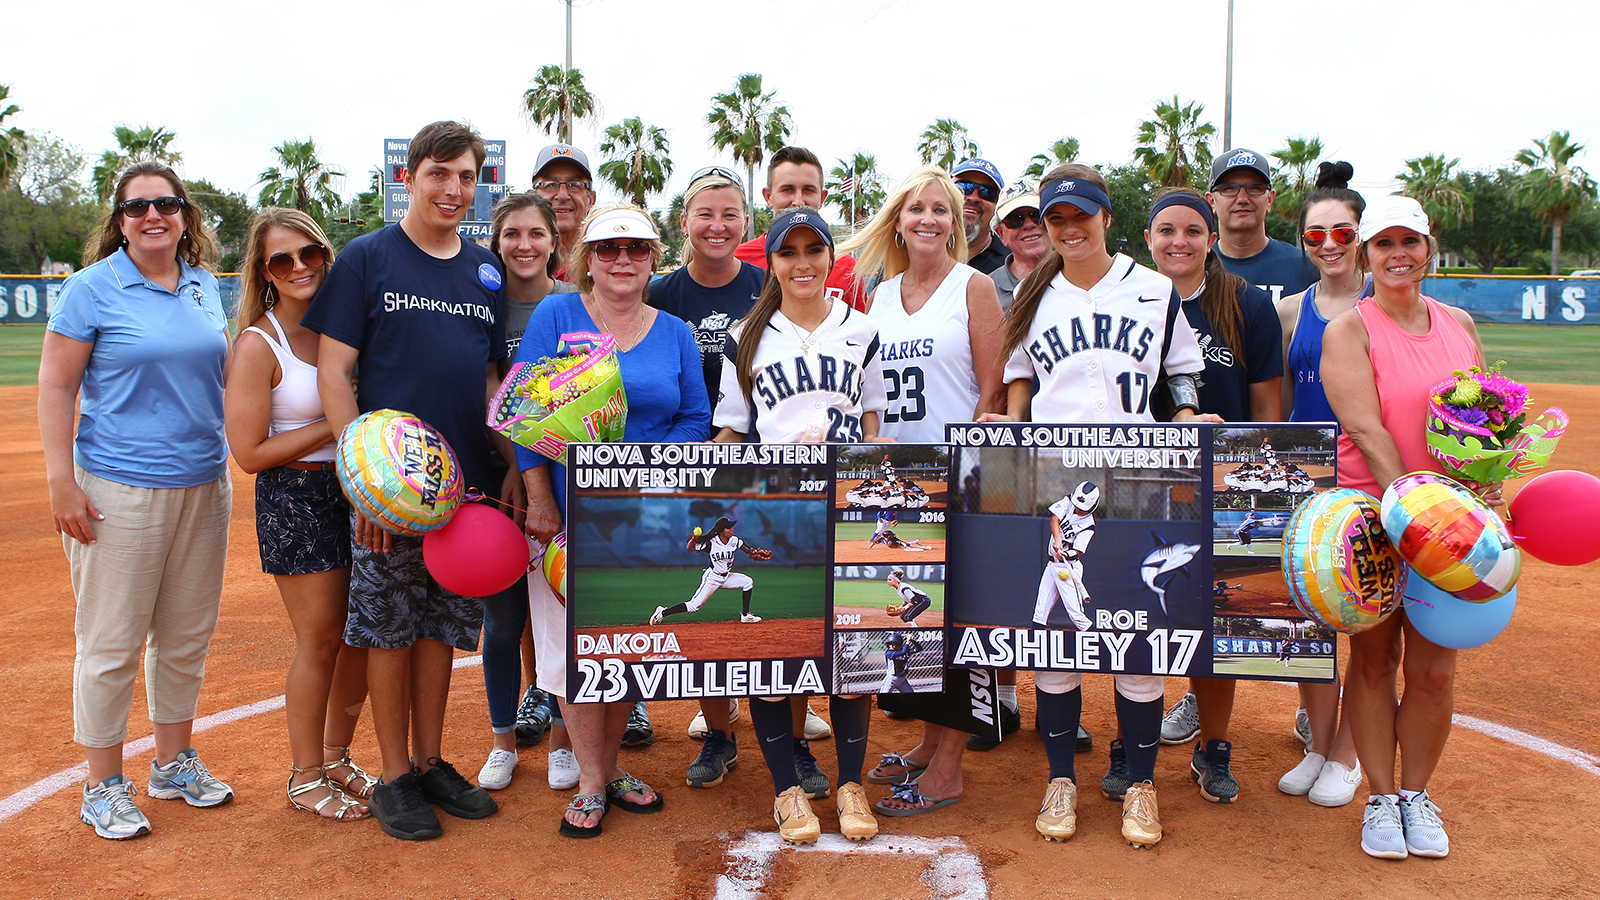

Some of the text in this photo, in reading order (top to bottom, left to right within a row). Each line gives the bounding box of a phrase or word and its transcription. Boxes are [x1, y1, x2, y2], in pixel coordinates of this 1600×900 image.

[387, 141, 407, 151] Nova
[1227, 155, 1257, 167] NSU
[383, 291, 496, 325] SHARKNATION
[698, 317, 731, 331] NSU
[1029, 312, 1155, 376] SHARKS
[755, 352, 864, 412] SHARKS
[1115, 371, 1149, 415] 17
[883, 366, 927, 424] 23
[824, 406, 863, 443] 23
[950, 427, 1199, 447] NOVA SOUTHEASTERN
[575, 445, 828, 465] NOVA SOUTHEASTERN
[1061, 449, 1201, 469] UNIVERSITY
[420, 451, 444, 510] MISS
[575, 467, 717, 488] UNIVERSITY
[799, 480, 827, 492] 2017
[919, 512, 946, 523] 2016
[1329, 536, 1347, 569] SEE
[1346, 523, 1380, 606] WE'LL
[1376, 556, 1396, 619] MISS
[835, 614, 861, 625] 2015
[1095, 609, 1148, 631] ROE
[576, 632, 682, 656] DAKOTA
[917, 630, 943, 642] 2014
[1310, 641, 1332, 654] SO
[952, 626, 1204, 676] ASHLEY 17
[573, 658, 826, 704] 23 VILLELLA
[968, 668, 994, 726] NSU
